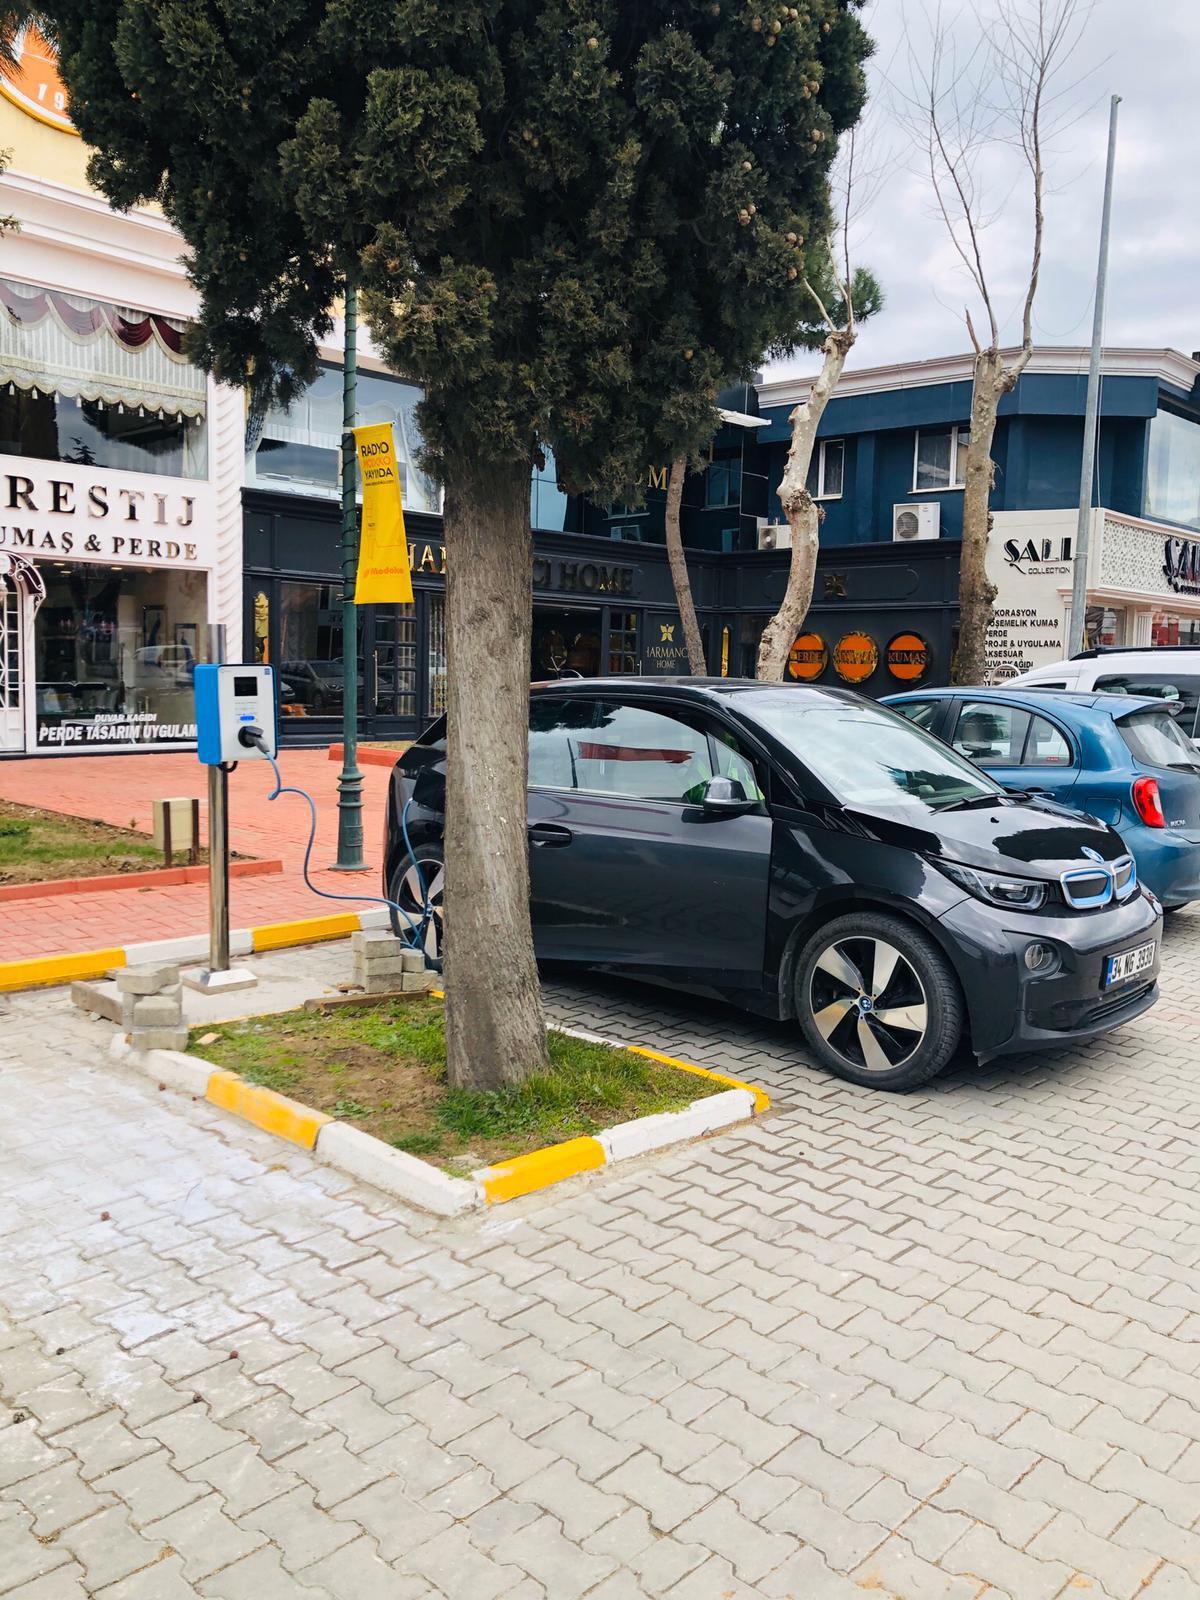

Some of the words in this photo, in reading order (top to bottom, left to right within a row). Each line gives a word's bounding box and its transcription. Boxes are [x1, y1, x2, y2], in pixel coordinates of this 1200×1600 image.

[361, 441, 389, 457] RADYO
[84, 533, 101, 551] &
[112, 536, 197, 560] PERDE
[559, 561, 634, 593] HOME
[1028, 566, 1071, 575] COLLECTION
[992, 609, 1037, 617] KORASYON
[1030, 618, 1059, 629] KUMAŞ
[1009, 639, 1015, 648] &
[1017, 639, 1062, 648] UYGULAMA
[94, 713, 124, 723] DUVAR
[38, 726, 83, 741] PERDE
[86, 724, 140, 740] TASARIM
[1111, 958, 1122, 980] 34
[1124, 952, 1135, 976] NG
